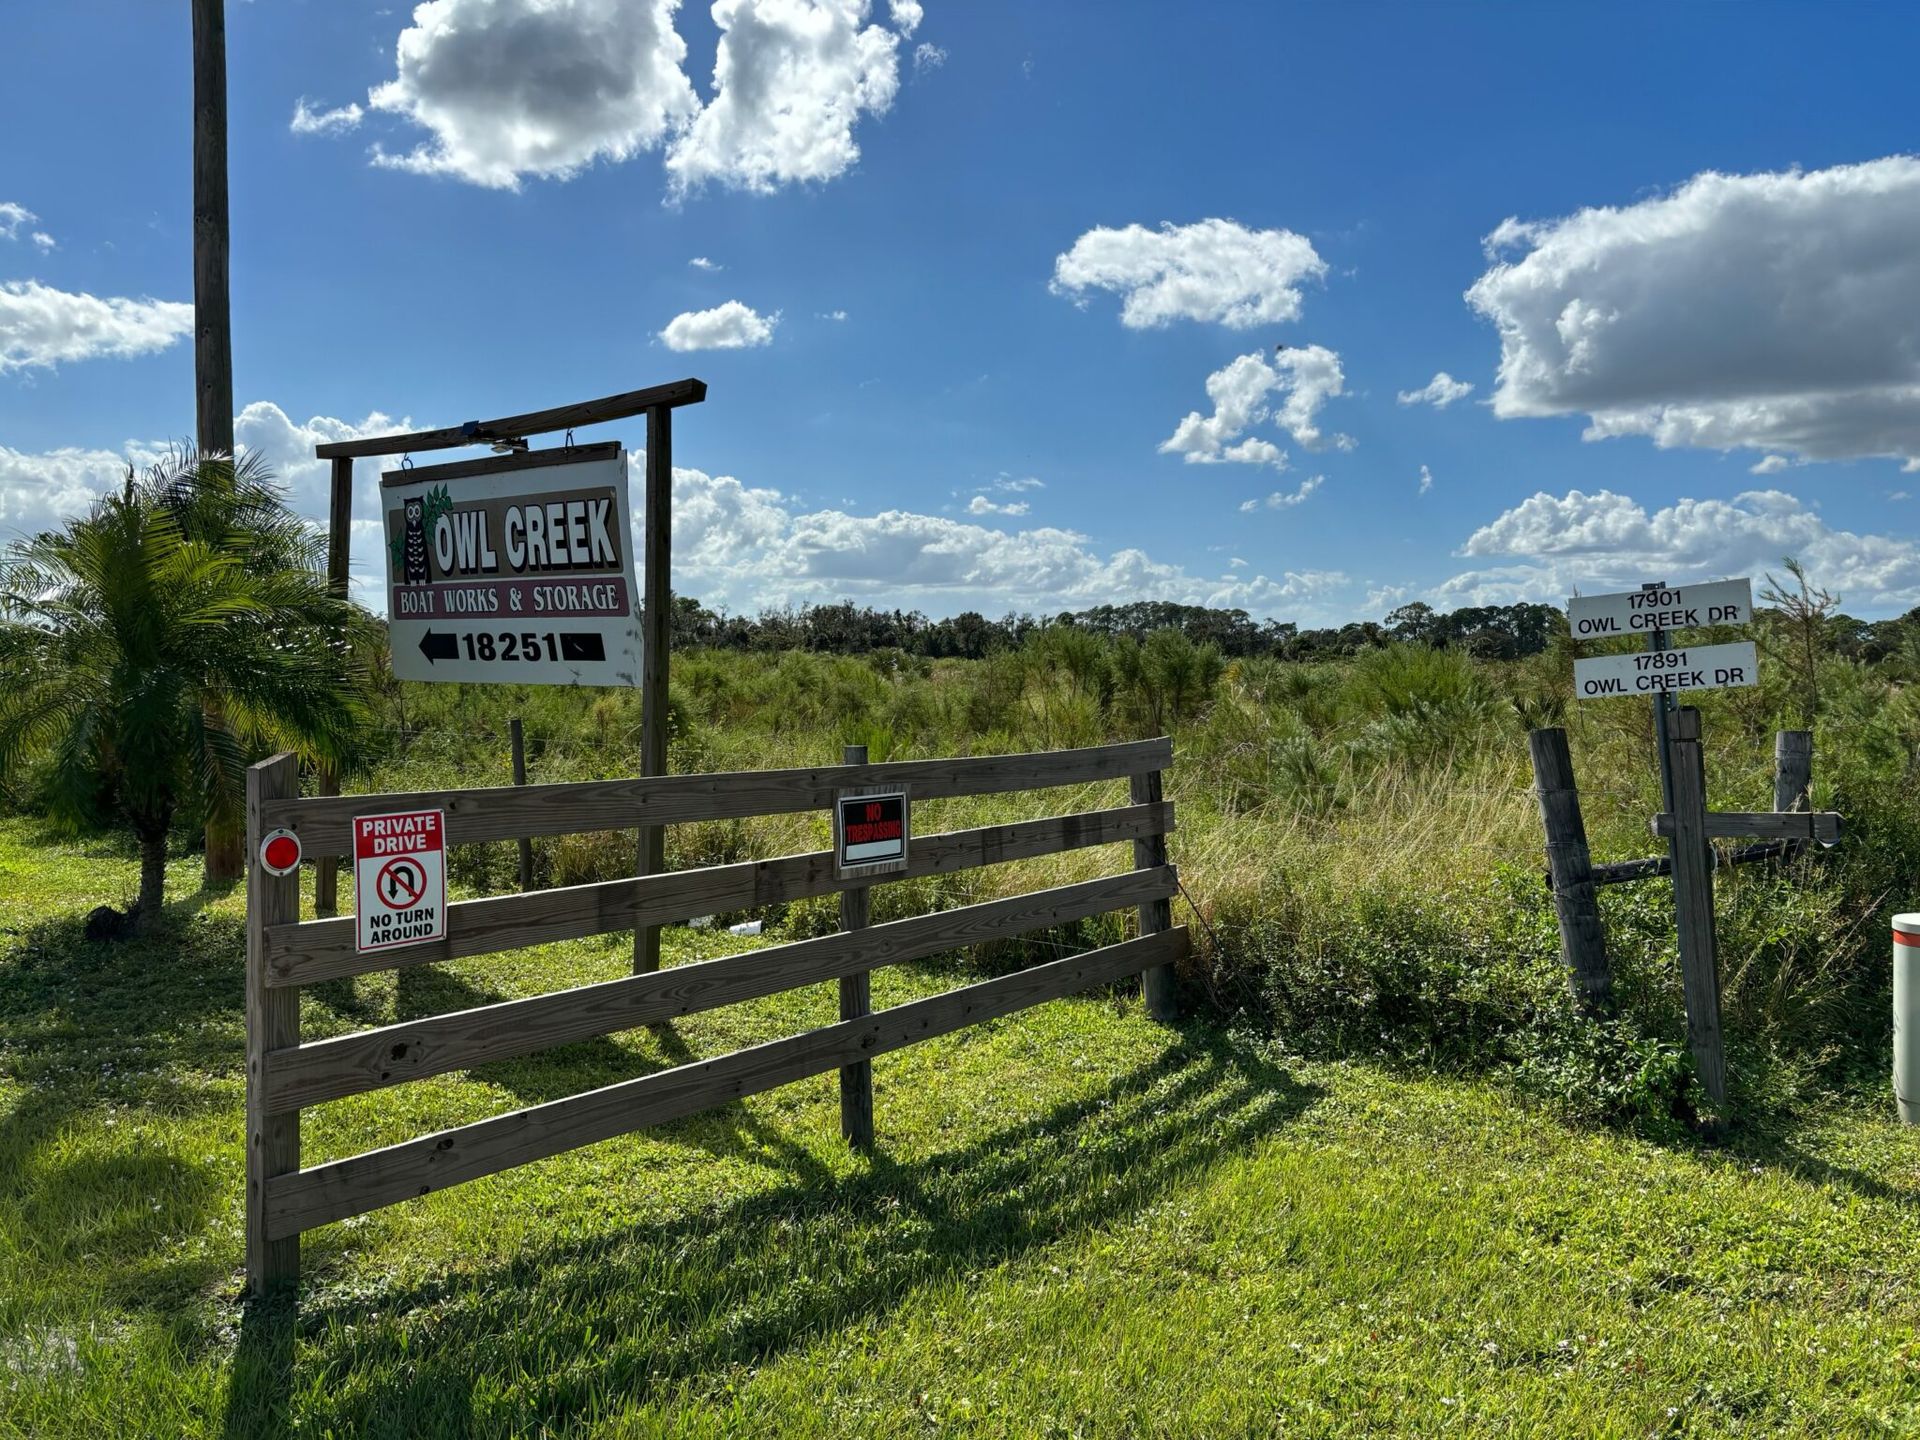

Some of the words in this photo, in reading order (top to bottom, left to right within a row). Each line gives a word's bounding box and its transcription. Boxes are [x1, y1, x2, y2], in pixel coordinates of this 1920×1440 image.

[435, 510, 498, 575] OWL
[504, 498, 619, 572] CREEK
[400, 590, 435, 614] BOAT
[443, 588, 499, 612] WORKS
[509, 587, 522, 611] &
[533, 584, 619, 611] STORAGE
[1627, 590, 1681, 609] 17901
[1578, 617, 1621, 634] OWL
[1630, 609, 1699, 629] CREEK
[1708, 605, 1738, 621] DR
[462, 632, 559, 662] 18251
[1633, 652, 1688, 670] 17891
[1584, 678, 1627, 695] OWL
[1636, 670, 1705, 691] CREEK
[1715, 667, 1744, 684] DR
[866, 803, 881, 821] NO
[362, 815, 436, 837] PRIVATE
[847, 820, 901, 842] TRESPASSING
[374, 834, 426, 854] DRIVE
[370, 914, 391, 929] NO
[395, 907, 434, 925] TURN
[371, 923, 434, 944] AROUND
